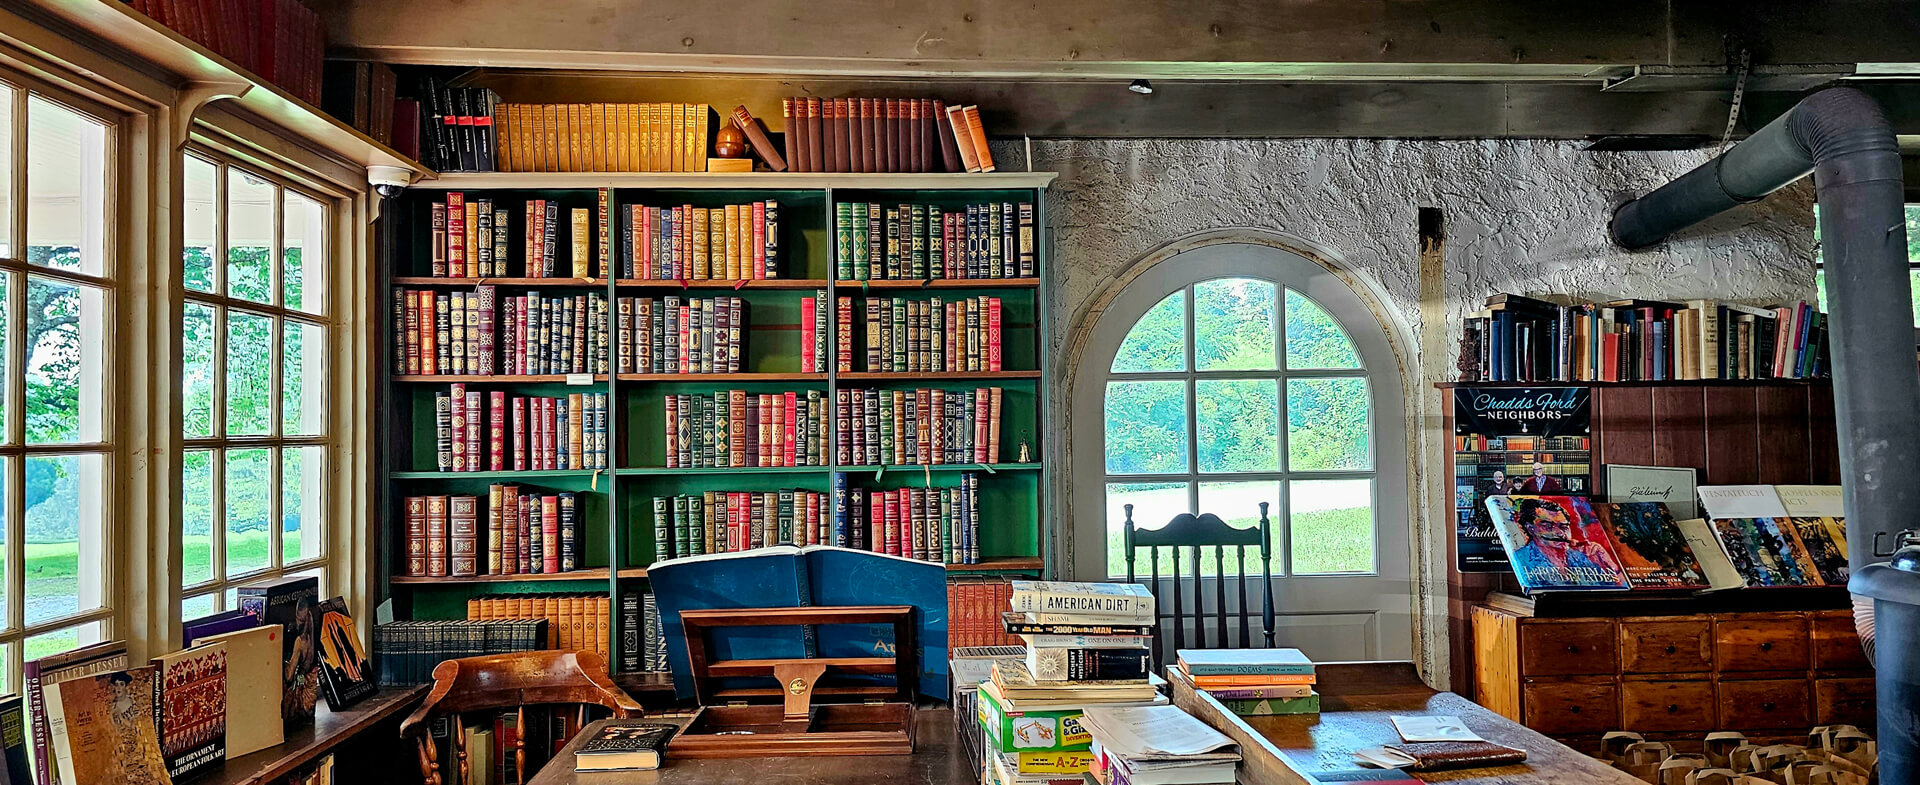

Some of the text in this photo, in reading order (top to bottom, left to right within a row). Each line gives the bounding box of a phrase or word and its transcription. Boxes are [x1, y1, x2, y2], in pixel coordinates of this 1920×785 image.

[1474, 393, 1576, 411] Chadds Ford
[1487, 411, 1562, 420] NEIGHBORS
[1703, 489, 1764, 498] PENTATEUCH
[1047, 596, 1102, 611] AMERICAN
[1105, 599, 1130, 612] DIRT
[1053, 626, 1073, 634] 2000
[1093, 626, 1112, 634] MAN
[47, 656, 126, 684] OLIVER MESSEL
[31, 677, 45, 749] OLIVER MESSEL
[1063, 728, 1070, 736] &
[171, 757, 201, 778] EUROPEAN
[213, 748, 225, 759] ART
[174, 743, 215, 767] THE ORNAMENT
[1055, 756, 1065, 768] A
[1069, 756, 1079, 768] Z
